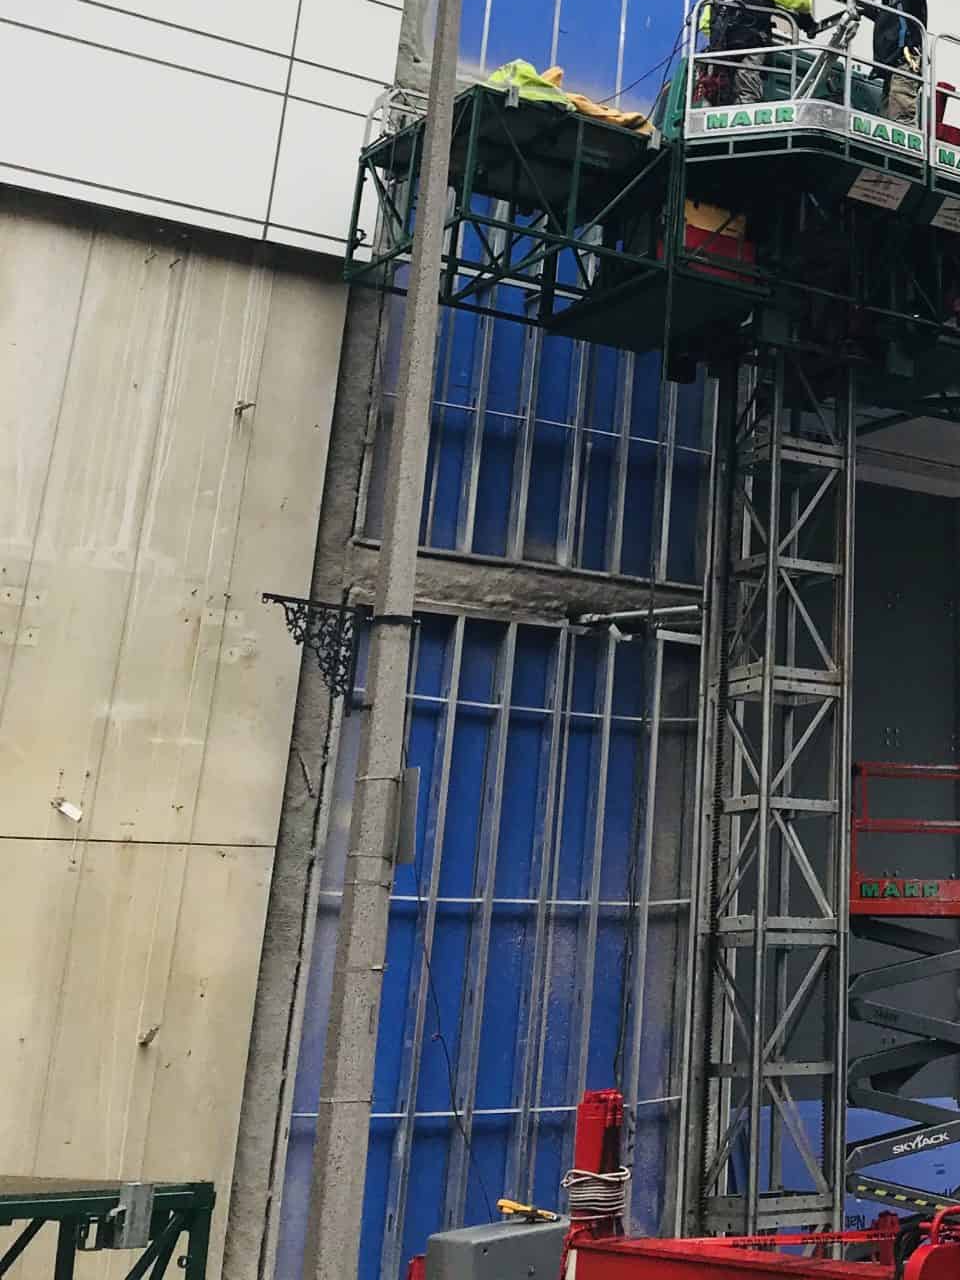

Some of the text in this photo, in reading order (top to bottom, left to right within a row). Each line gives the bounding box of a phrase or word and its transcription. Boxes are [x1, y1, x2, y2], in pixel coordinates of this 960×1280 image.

[706, 107, 794, 130] MARR
[853, 116, 922, 150] MARR
[861, 882, 940, 898] MARR
